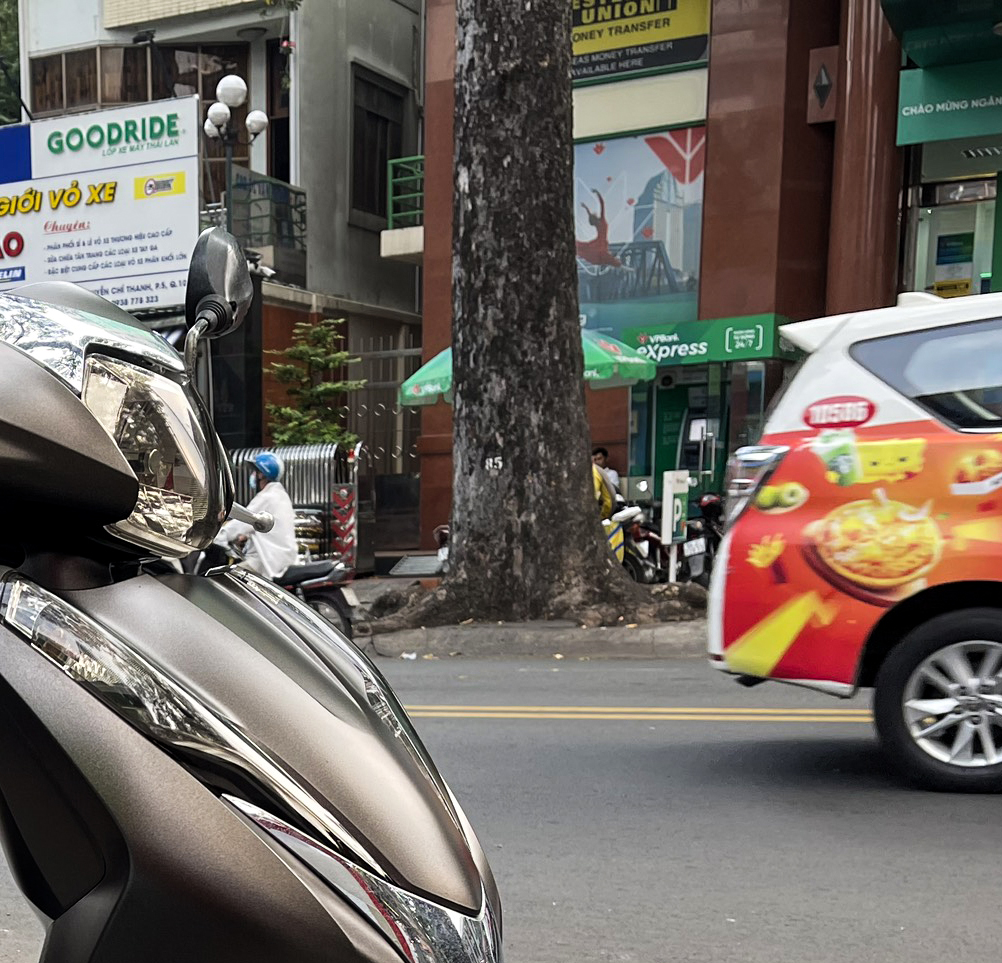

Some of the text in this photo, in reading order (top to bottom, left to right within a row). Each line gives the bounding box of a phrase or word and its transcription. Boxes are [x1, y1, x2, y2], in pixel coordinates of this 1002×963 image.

[581, 0, 655, 24] UNION
[572, 17, 671, 43] ONEY TRANSFER
[47, 113, 180, 155] GOODRIDE
[49, 180, 82, 209] VỎ
[86, 181, 117, 205] XE
